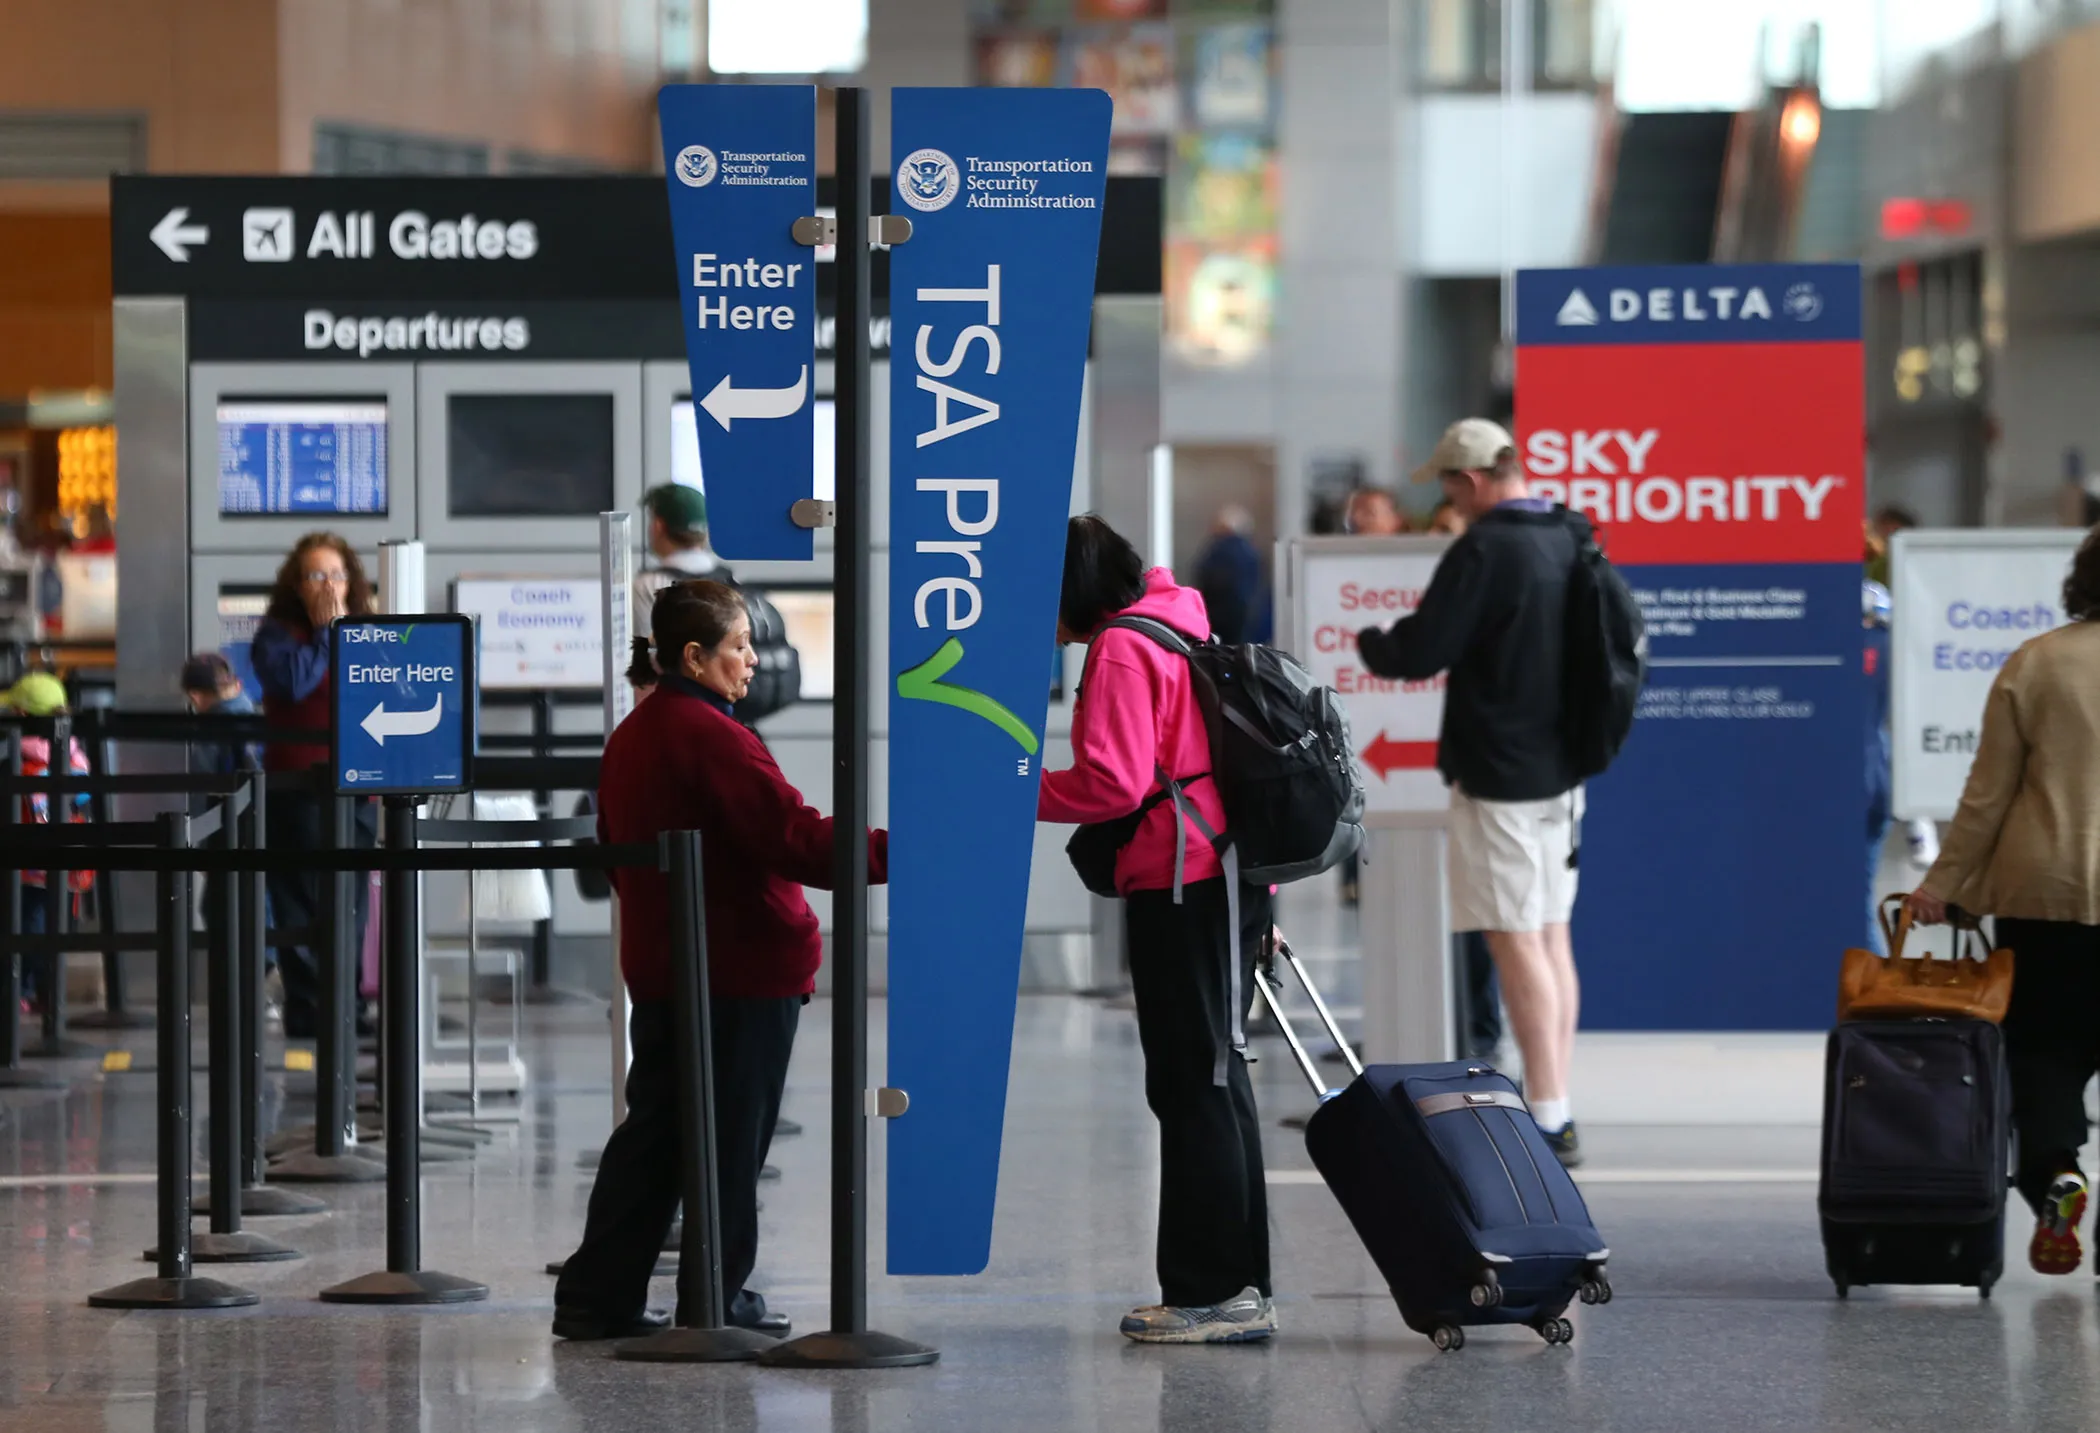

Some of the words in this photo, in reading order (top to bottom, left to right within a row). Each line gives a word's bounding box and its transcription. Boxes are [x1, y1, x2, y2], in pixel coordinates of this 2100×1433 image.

[721, 151, 806, 164] Transportation
[721, 163, 769, 176] Security
[966, 157, 1093, 176] Transportation
[721, 175, 808, 186] Administration
[966, 176, 1038, 194] Security
[966, 194, 1096, 209] Administration
[306, 210, 375, 259] All
[388, 209, 539, 260] Gates
[693, 253, 802, 288] Enter
[698, 296, 795, 330] Here
[1609, 286, 1773, 322] DELTA
[303, 309, 531, 359] Departures
[915, 264, 1001, 449] TSA
[1526, 428, 1660, 476] SKY
[914, 478, 999, 631] Pre
[509, 586, 572, 606] Coach
[1340, 582, 1424, 611] Secu
[1946, 601, 2055, 630] Coach
[343, 629, 370, 643] TSA
[374, 628, 398, 642] Pre
[348, 664, 402, 683] Enter
[406, 663, 454, 682] Here
[1640, 687, 1682, 704] ANTIC
[1921, 724, 1978, 753] Ent
[1017, 757, 1028, 776] TM
